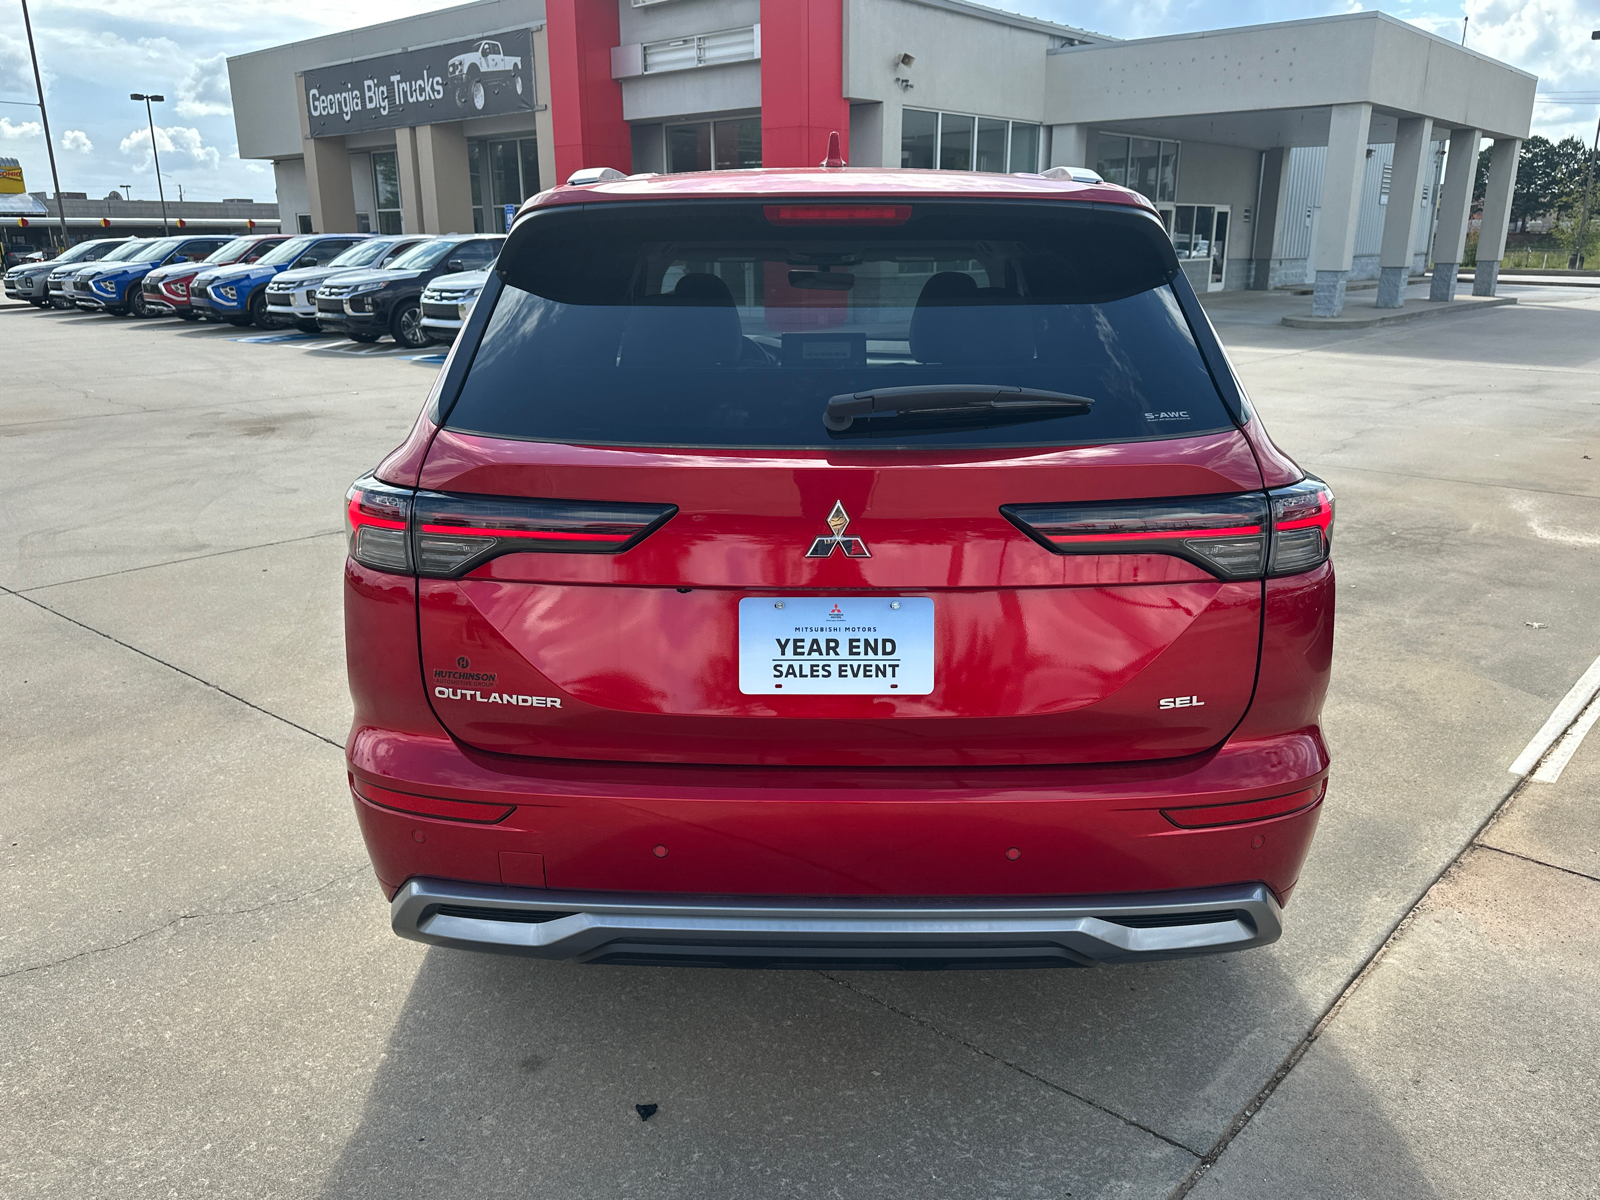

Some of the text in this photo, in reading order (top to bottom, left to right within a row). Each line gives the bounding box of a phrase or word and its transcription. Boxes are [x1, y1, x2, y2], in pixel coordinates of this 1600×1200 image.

[309, 69, 444, 121] Georgia Big Trucks
[1144, 411, 1189, 419] S-AWC
[775, 638, 897, 656] YEAR END
[433, 670, 496, 681] HUTCHINSON
[772, 663, 900, 679] SALES EVENT
[435, 678, 472, 687] AUTOMOTIVE
[434, 686, 564, 709] OUTLANDER
[1159, 695, 1206, 710] SEL
